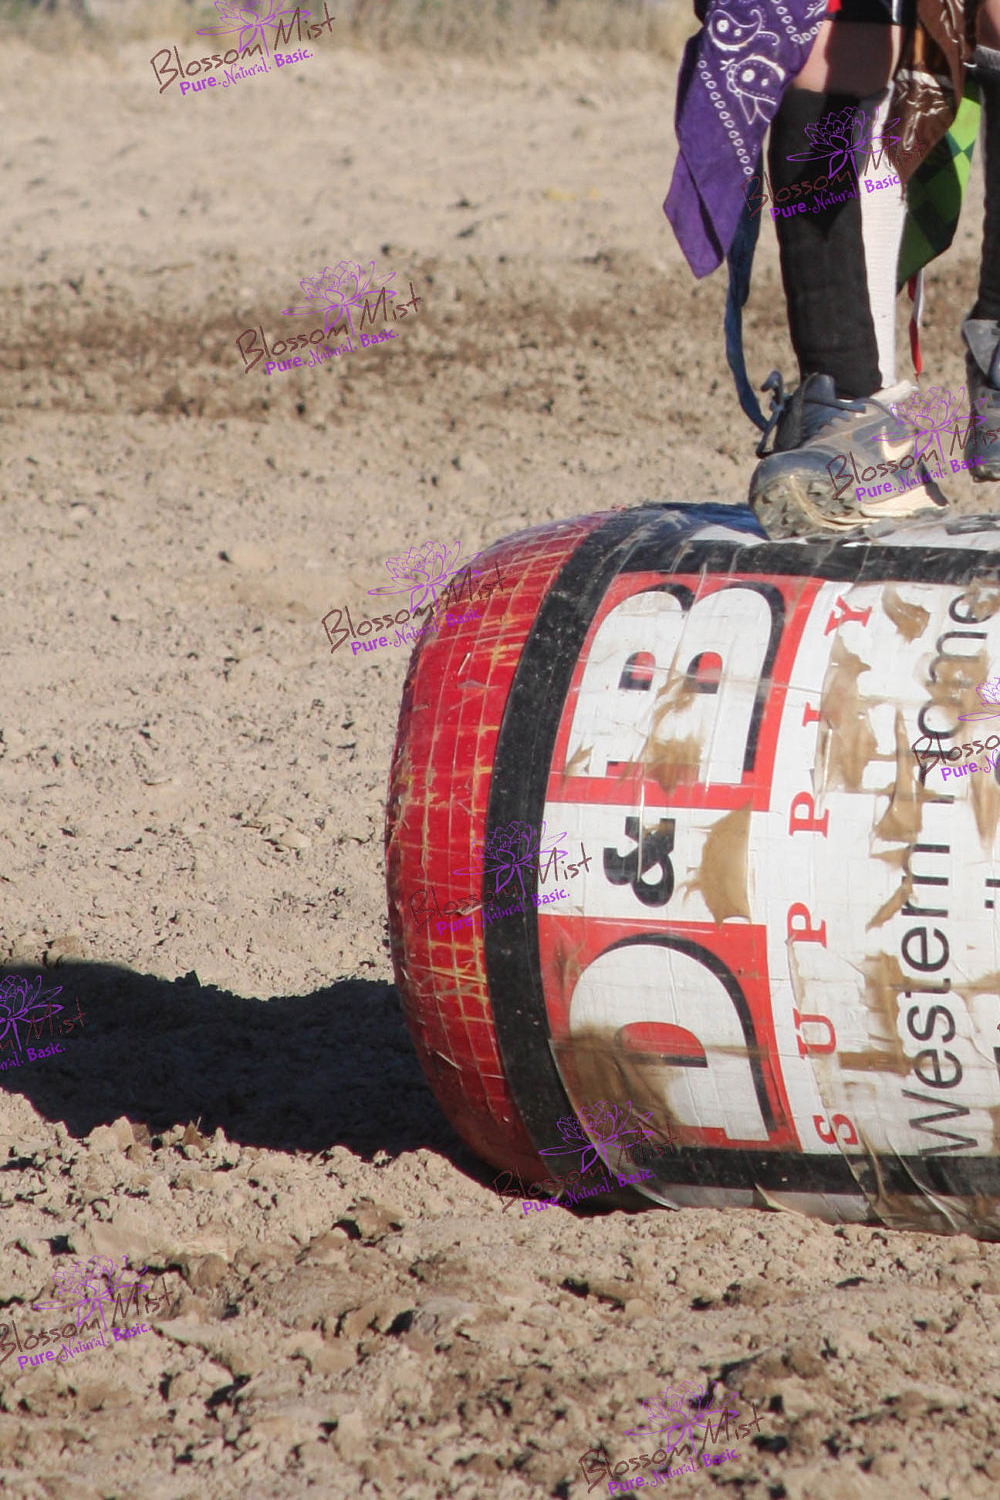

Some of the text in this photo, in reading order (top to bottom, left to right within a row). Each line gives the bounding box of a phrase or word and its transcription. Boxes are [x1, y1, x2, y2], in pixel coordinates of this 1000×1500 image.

[565, 580, 785, 1143] D & B
[901, 842, 978, 1157] Western
